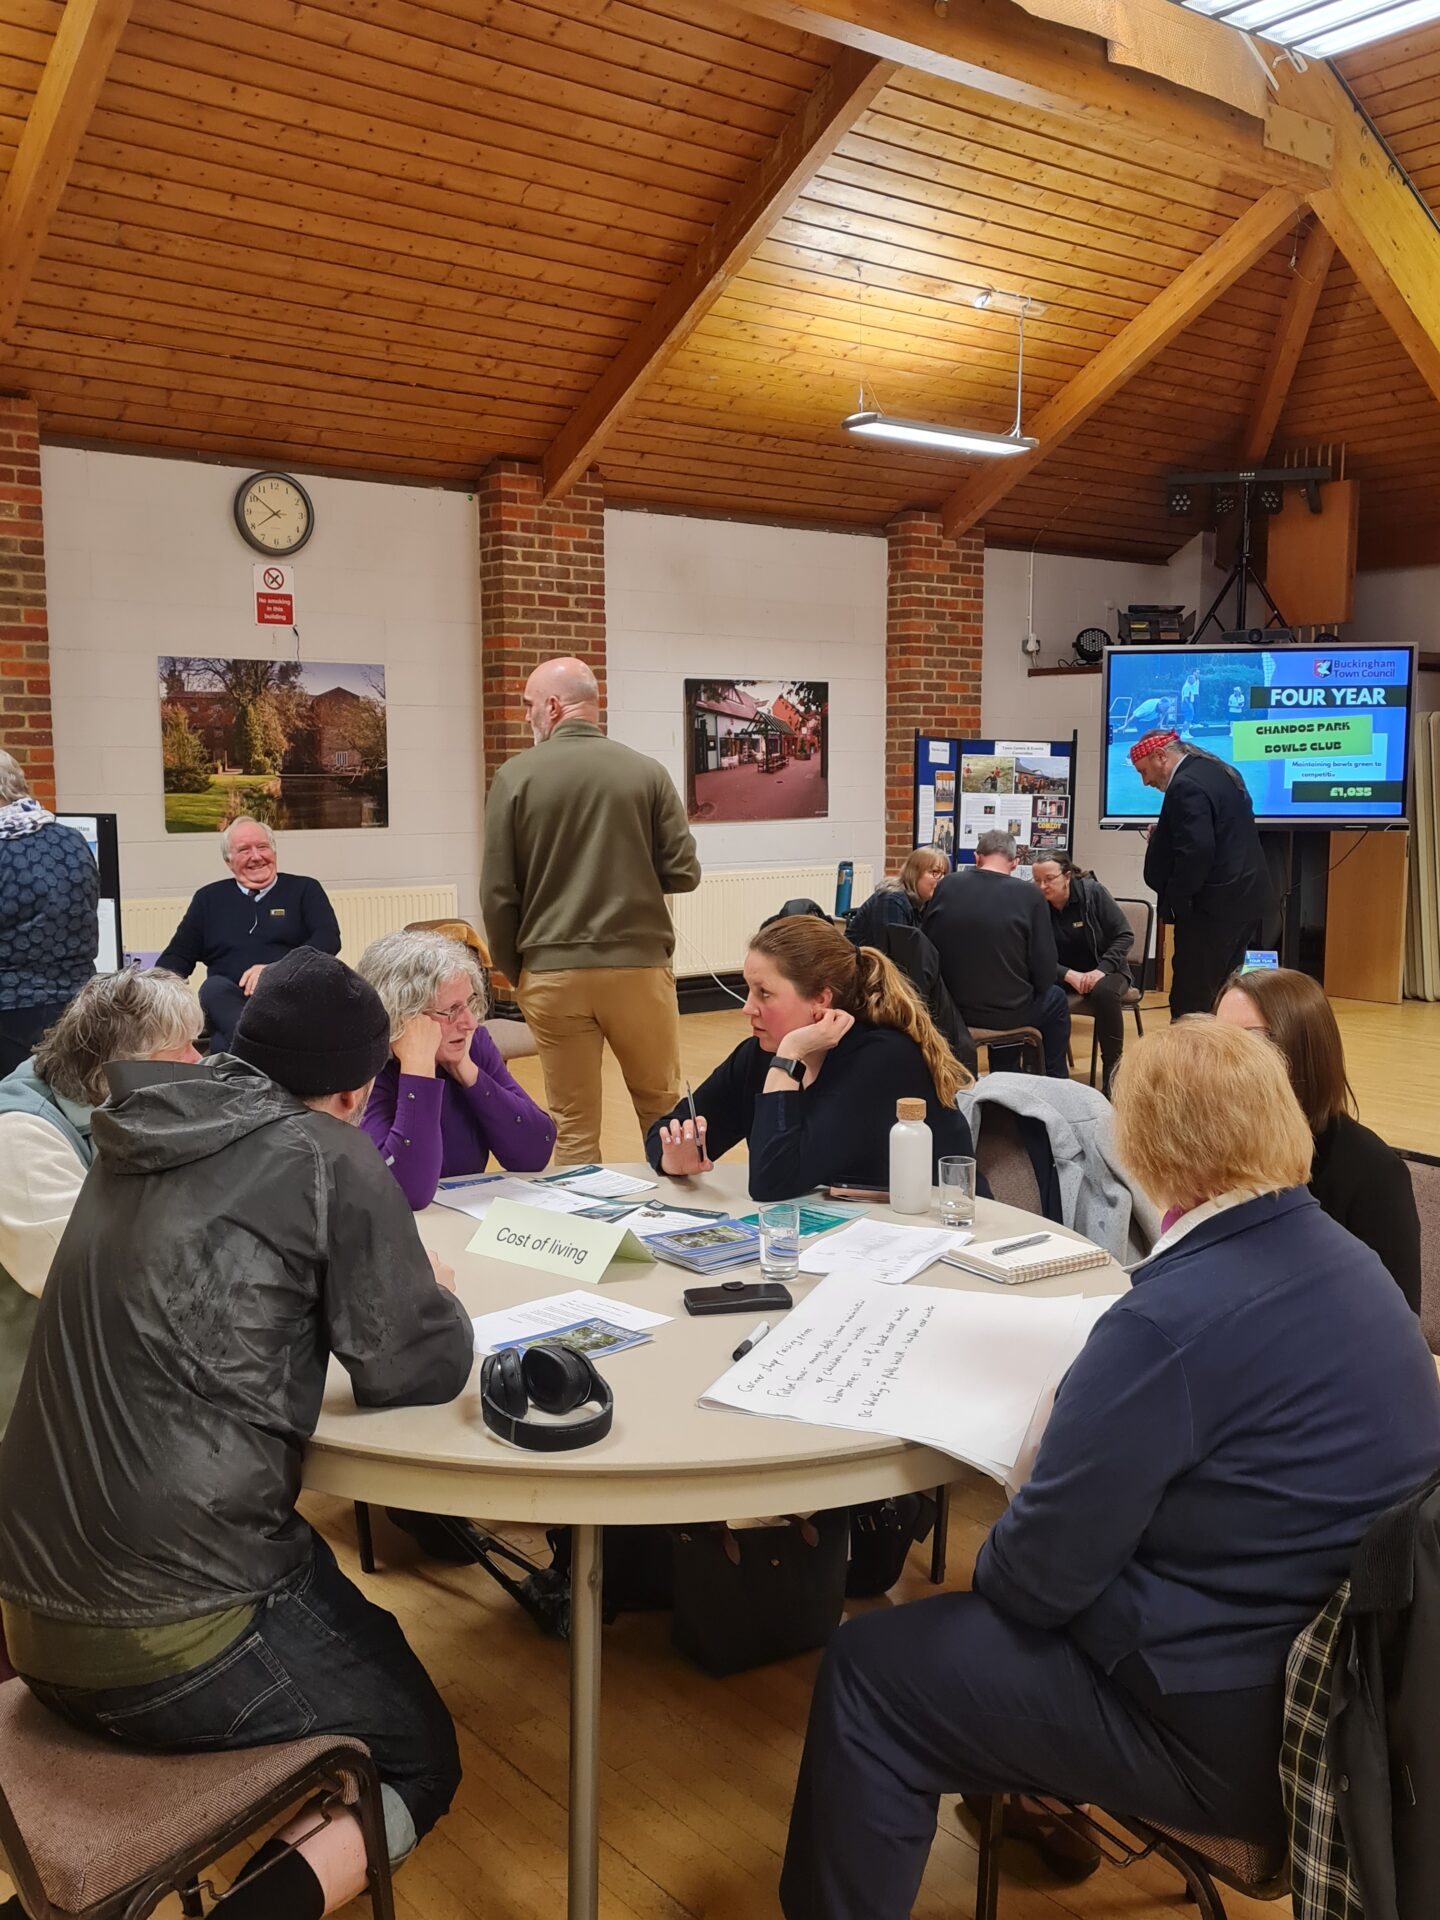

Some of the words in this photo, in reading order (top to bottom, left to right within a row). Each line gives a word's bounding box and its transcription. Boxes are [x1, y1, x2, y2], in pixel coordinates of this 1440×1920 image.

[1334, 659, 1396, 673] Buckingham
[1334, 669, 1360, 678] Town
[1361, 668, 1396, 678] Council
[1270, 688, 1326, 706] FOUR
[1332, 687, 1387, 705] YEAR
[1256, 723, 1315, 735] CHANDOS
[1317, 721, 1351, 733] PARK
[1264, 742, 1307, 754] BOWLS
[1310, 741, 1342, 751] CLUB
[1291, 761, 1331, 769] Maintaining
[1332, 760, 1353, 768] bowls
[1354, 761, 1374, 769] green
[1330, 787, 1372, 798] £1,035
[496, 1227, 531, 1248] Cost
[531, 1237, 551, 1252] of
[549, 1239, 589, 1265] living
[737, 1374, 765, 1392] Corner
[758, 1359, 784, 1373] shop
[776, 1340, 803, 1356] raising
